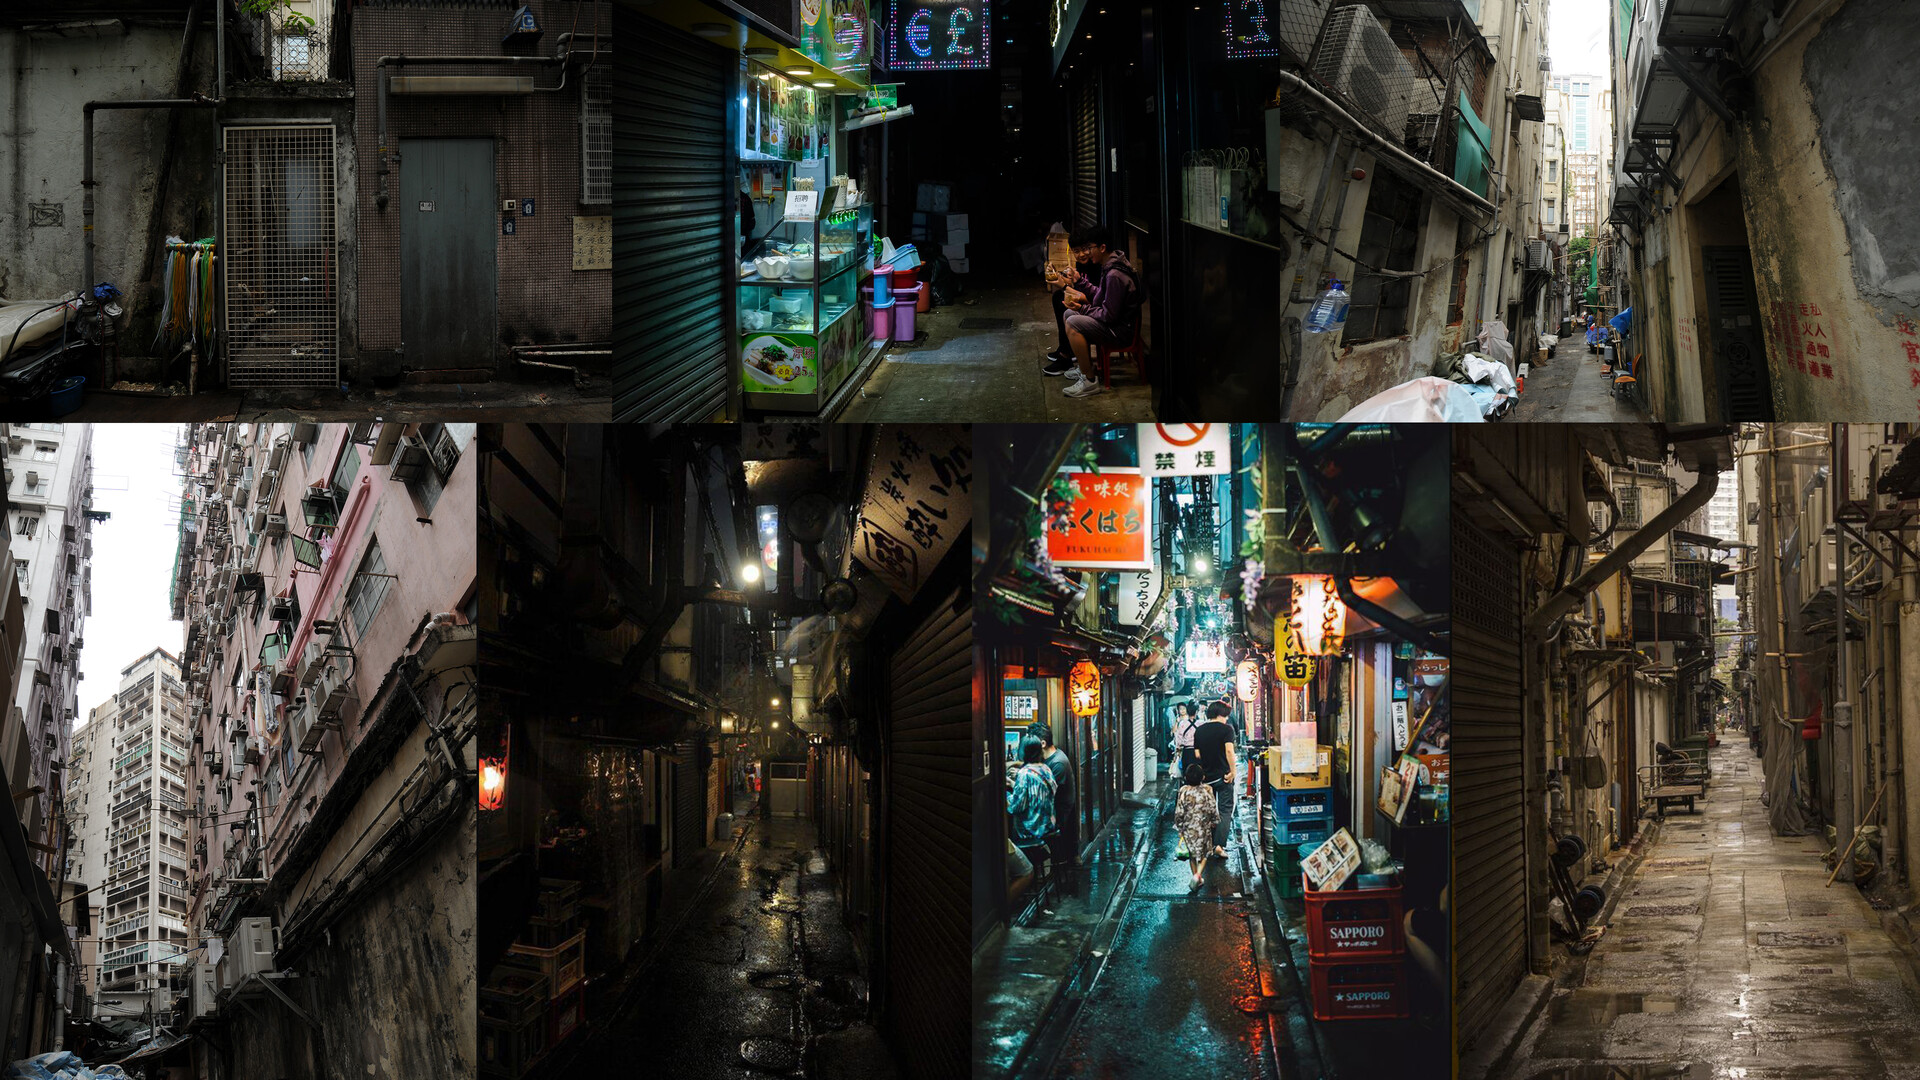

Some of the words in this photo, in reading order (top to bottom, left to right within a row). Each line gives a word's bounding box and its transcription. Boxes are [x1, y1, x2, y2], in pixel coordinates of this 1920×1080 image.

[905, 8, 932, 57] €
[947, 7, 974, 55] £
[1155, 450, 1216, 470] 禁煙
[1330, 926, 1385, 939] SAPPORO
[1346, 992, 1390, 1001] SAPPORO
